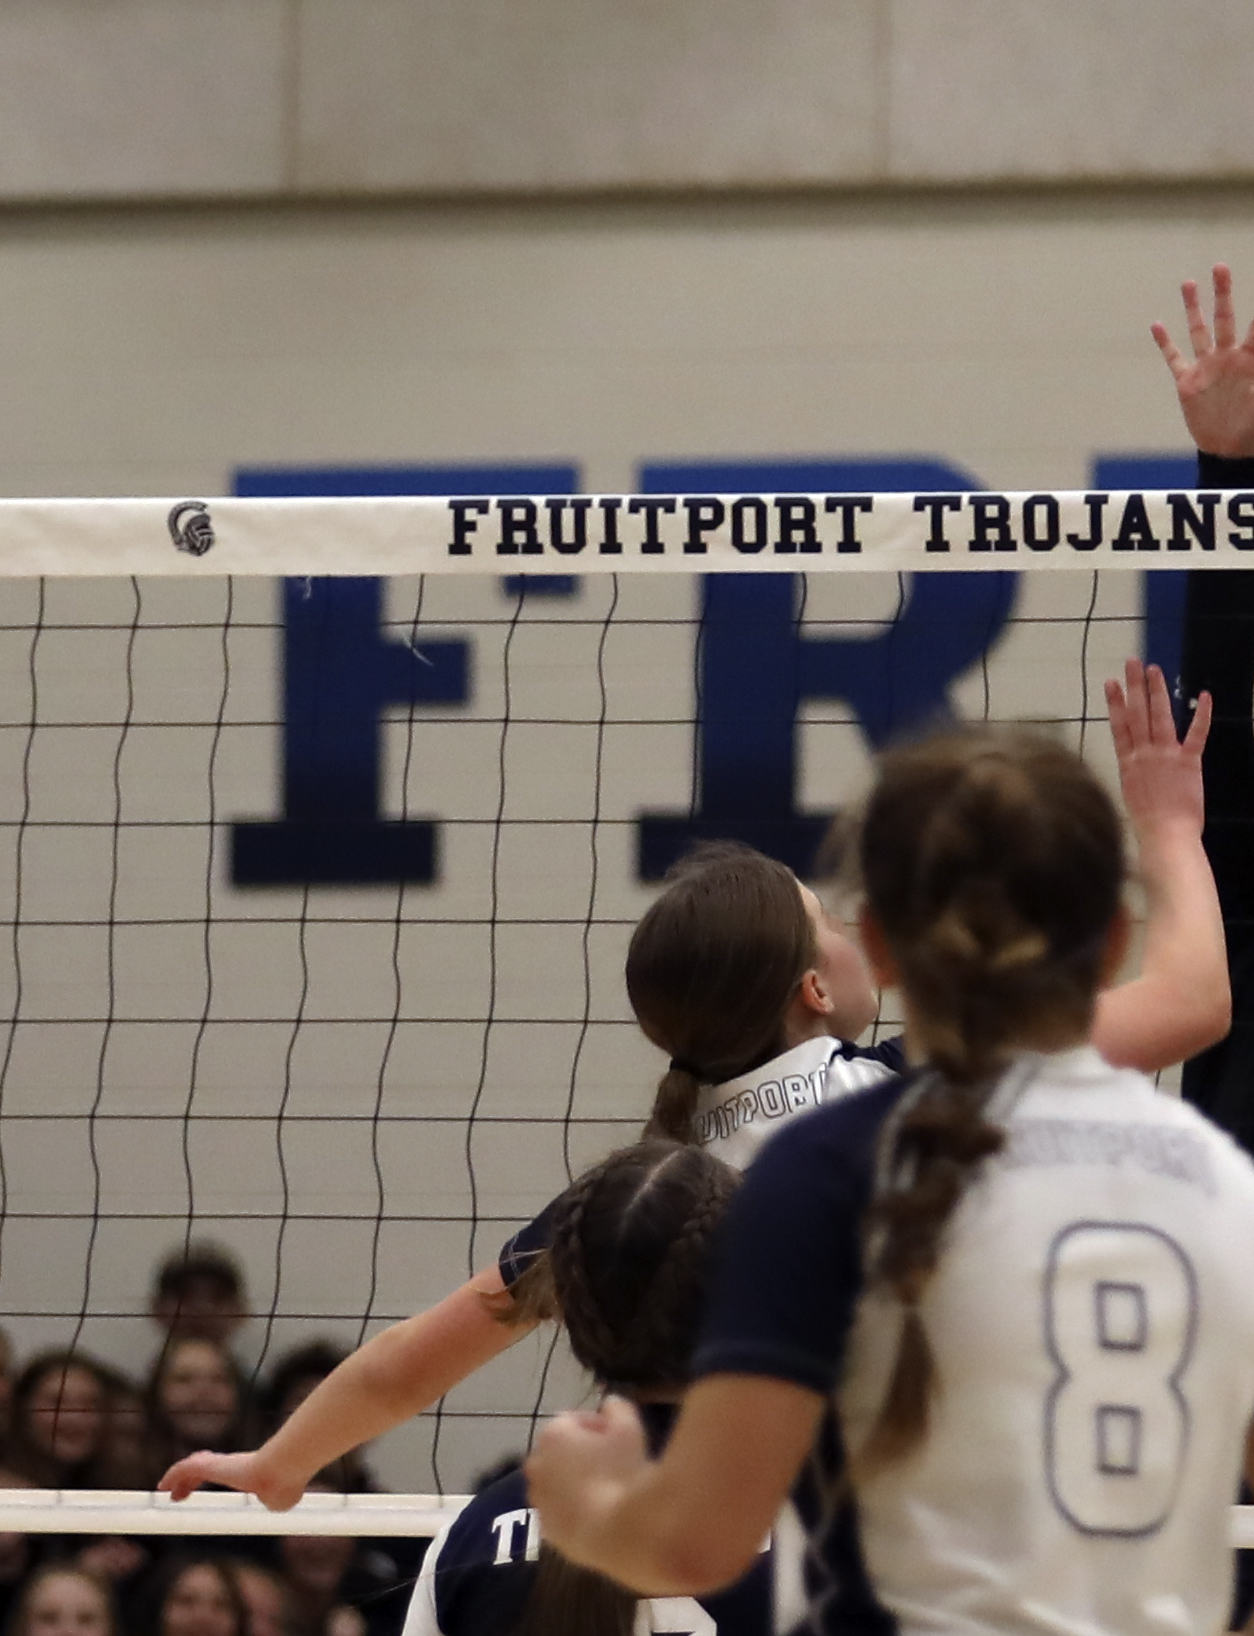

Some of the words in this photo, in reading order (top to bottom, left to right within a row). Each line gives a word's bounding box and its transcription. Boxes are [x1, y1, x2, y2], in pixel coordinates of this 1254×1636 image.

[447, 495, 874, 556] FRUITPORT
[696, 1061, 829, 1144] UITPORT
[1042, 1219, 1199, 1541] 8
